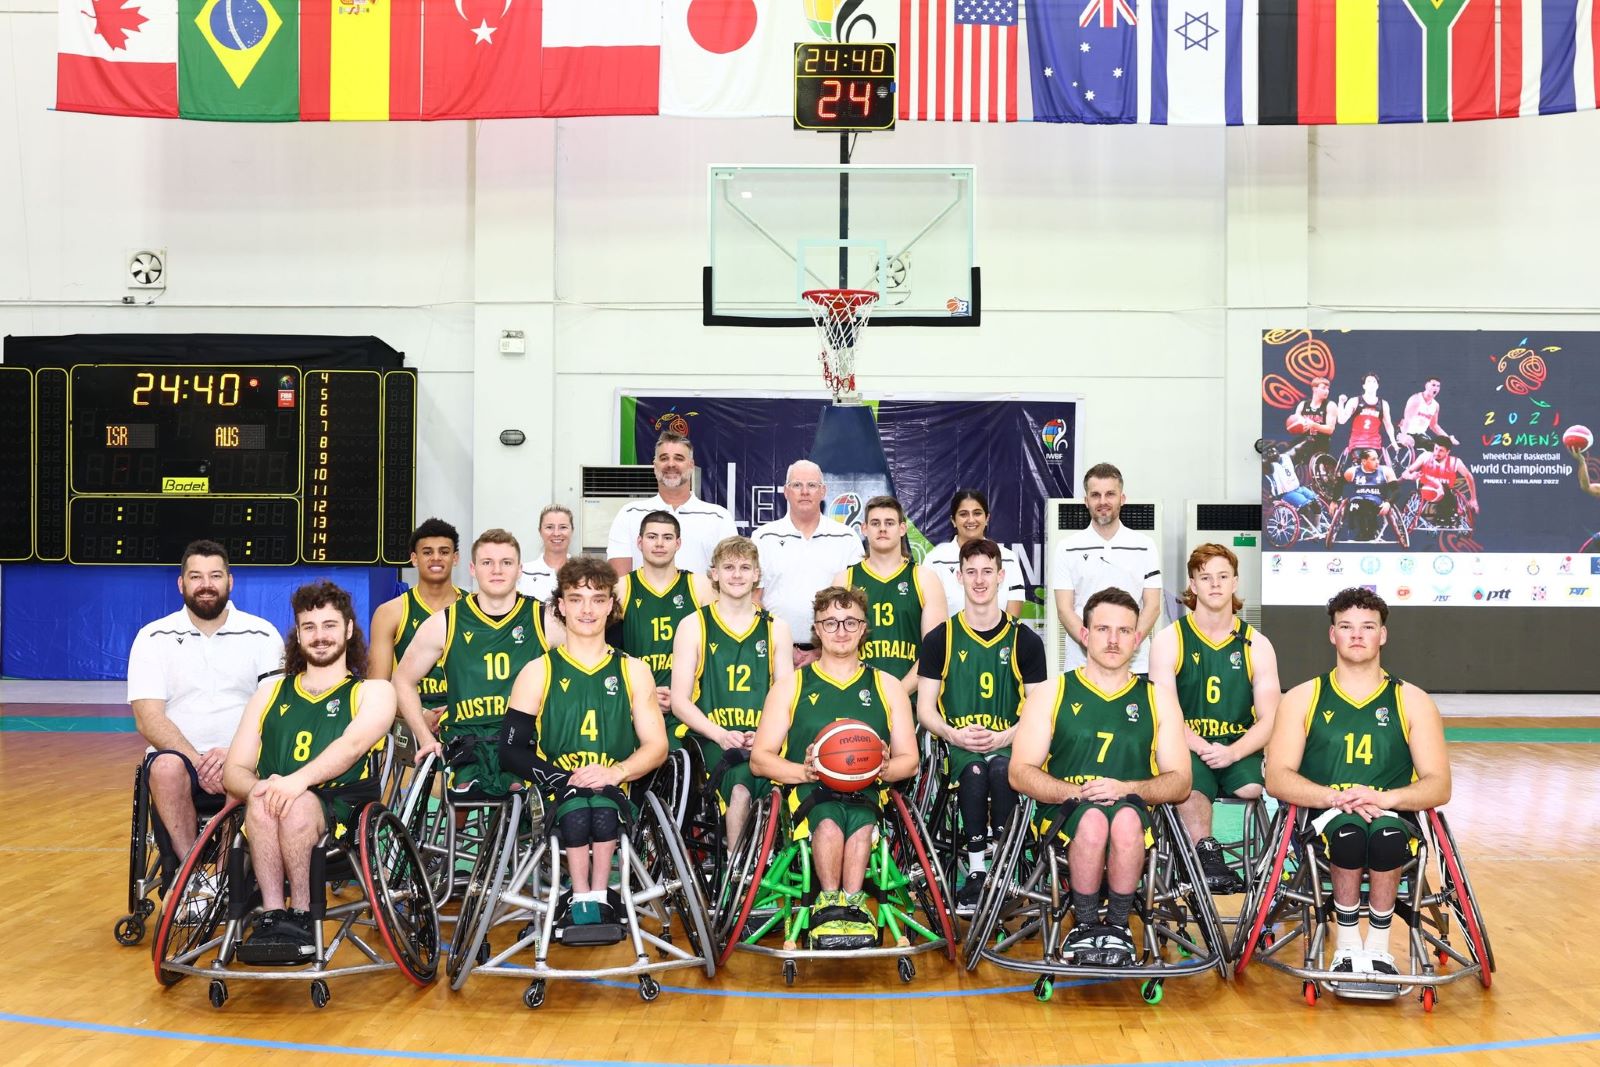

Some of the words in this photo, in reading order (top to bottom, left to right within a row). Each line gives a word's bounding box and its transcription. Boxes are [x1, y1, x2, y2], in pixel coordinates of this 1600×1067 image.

[804, 48, 885, 73] 24:40
[818, 80, 871, 118] 24
[321, 372, 329, 384] 4
[133, 372, 240, 406] 24:40
[320, 388, 328, 401] 5
[320, 404, 328, 417] 6
[321, 420, 328, 432] 7
[105, 425, 128, 446] ISR
[215, 426, 239, 447] AUS
[320, 436, 328, 448] 8
[1482, 433, 1512, 446] U23
[1515, 431, 1560, 447] MEN'S
[320, 452, 328, 465] 9
[1482, 452, 1522, 460] Wheelchair
[1523, 452, 1561, 460] Basketball
[314, 468, 328, 481] 10
[1470, 464, 1499, 475] World
[1501, 463, 1573, 476] Championship
[162, 479, 206, 492] Bodet
[313, 485, 327, 496] 11
[313, 500, 327, 513] 12
[313, 516, 327, 529] 13
[313, 532, 327, 544] 14
[312, 548, 326, 561] 15
[872, 602, 895, 627] 13
[650, 616, 674, 642] 15
[483, 652, 511, 681] 10
[726, 664, 751, 692] 12
[980, 672, 994, 699] 9
[1206, 675, 1221, 704] 6
[580, 709, 599, 742] 4
[293, 730, 313, 762] 8
[839, 734, 872, 745] molten
[1096, 731, 1114, 763] 7
[1344, 732, 1373, 765] 14
